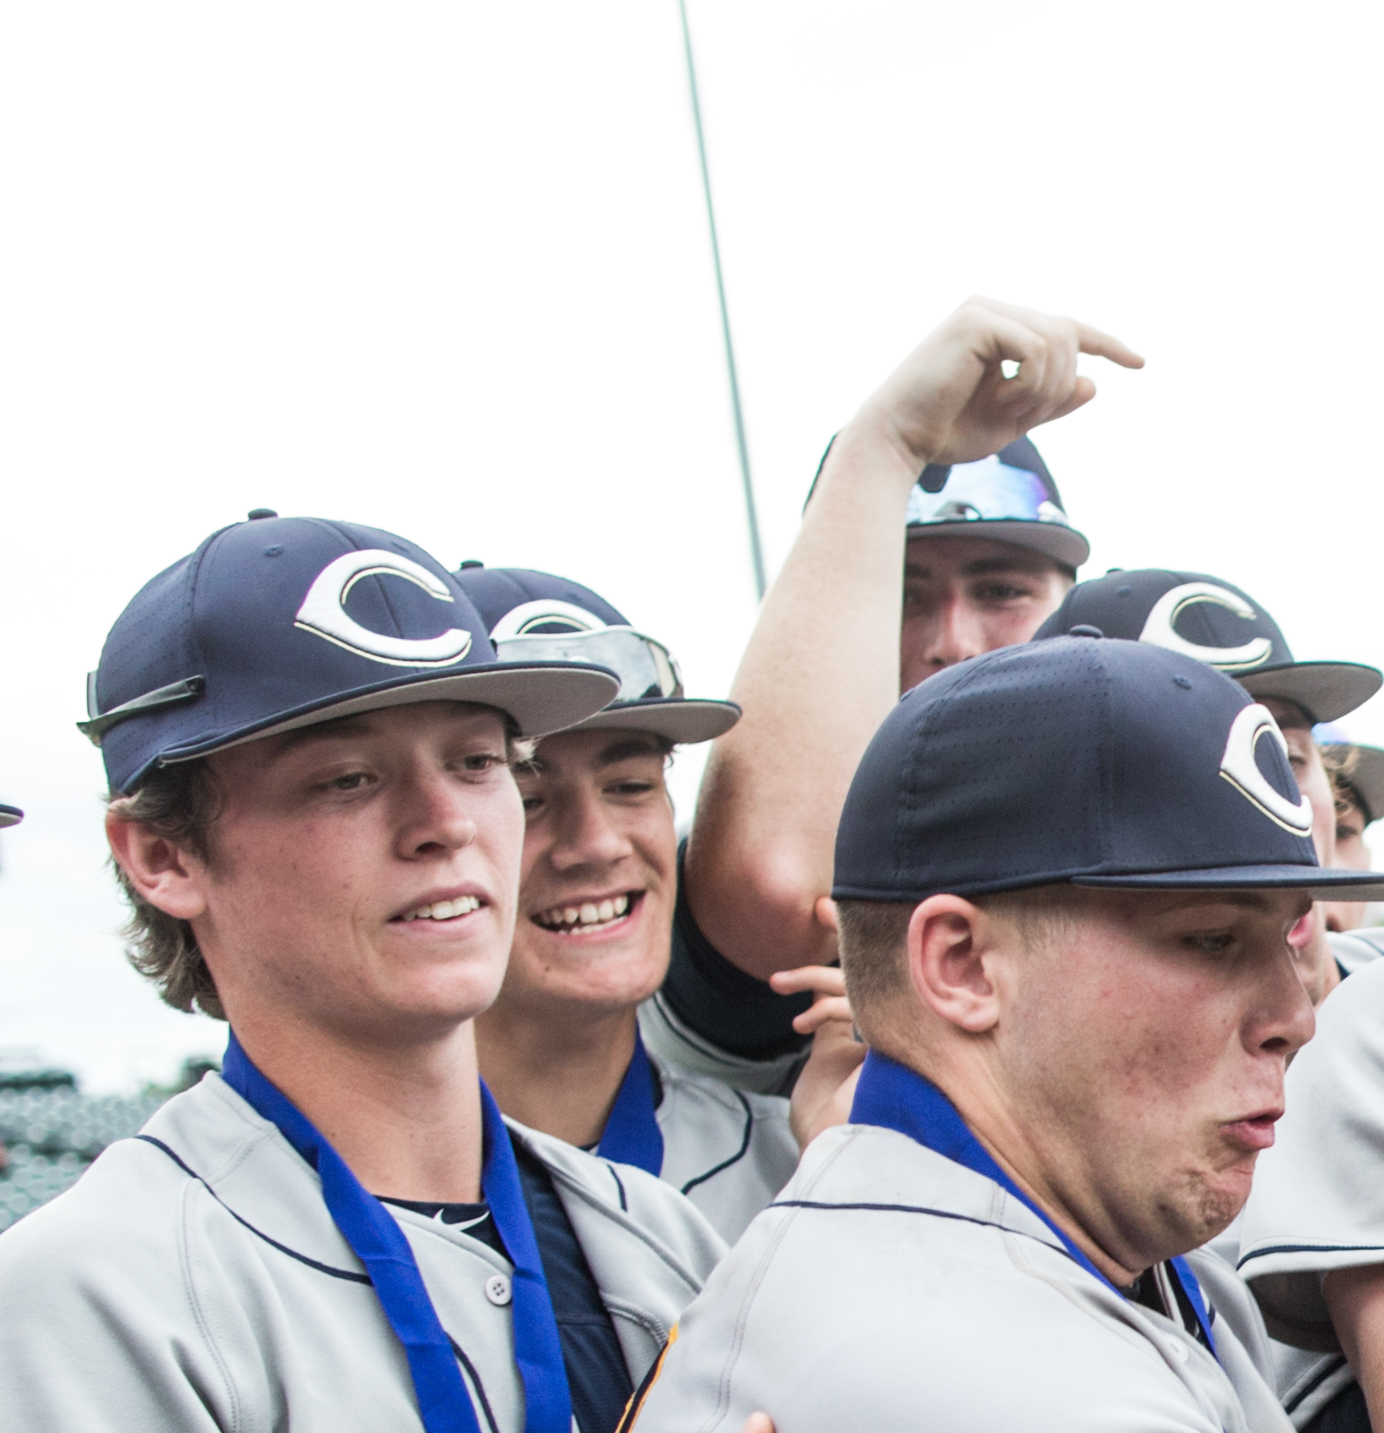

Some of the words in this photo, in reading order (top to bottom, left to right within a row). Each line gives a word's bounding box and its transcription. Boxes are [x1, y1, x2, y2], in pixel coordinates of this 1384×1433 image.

[293, 549, 473, 668] C
[1139, 582, 1273, 671] C
[1219, 703, 1314, 838] C
